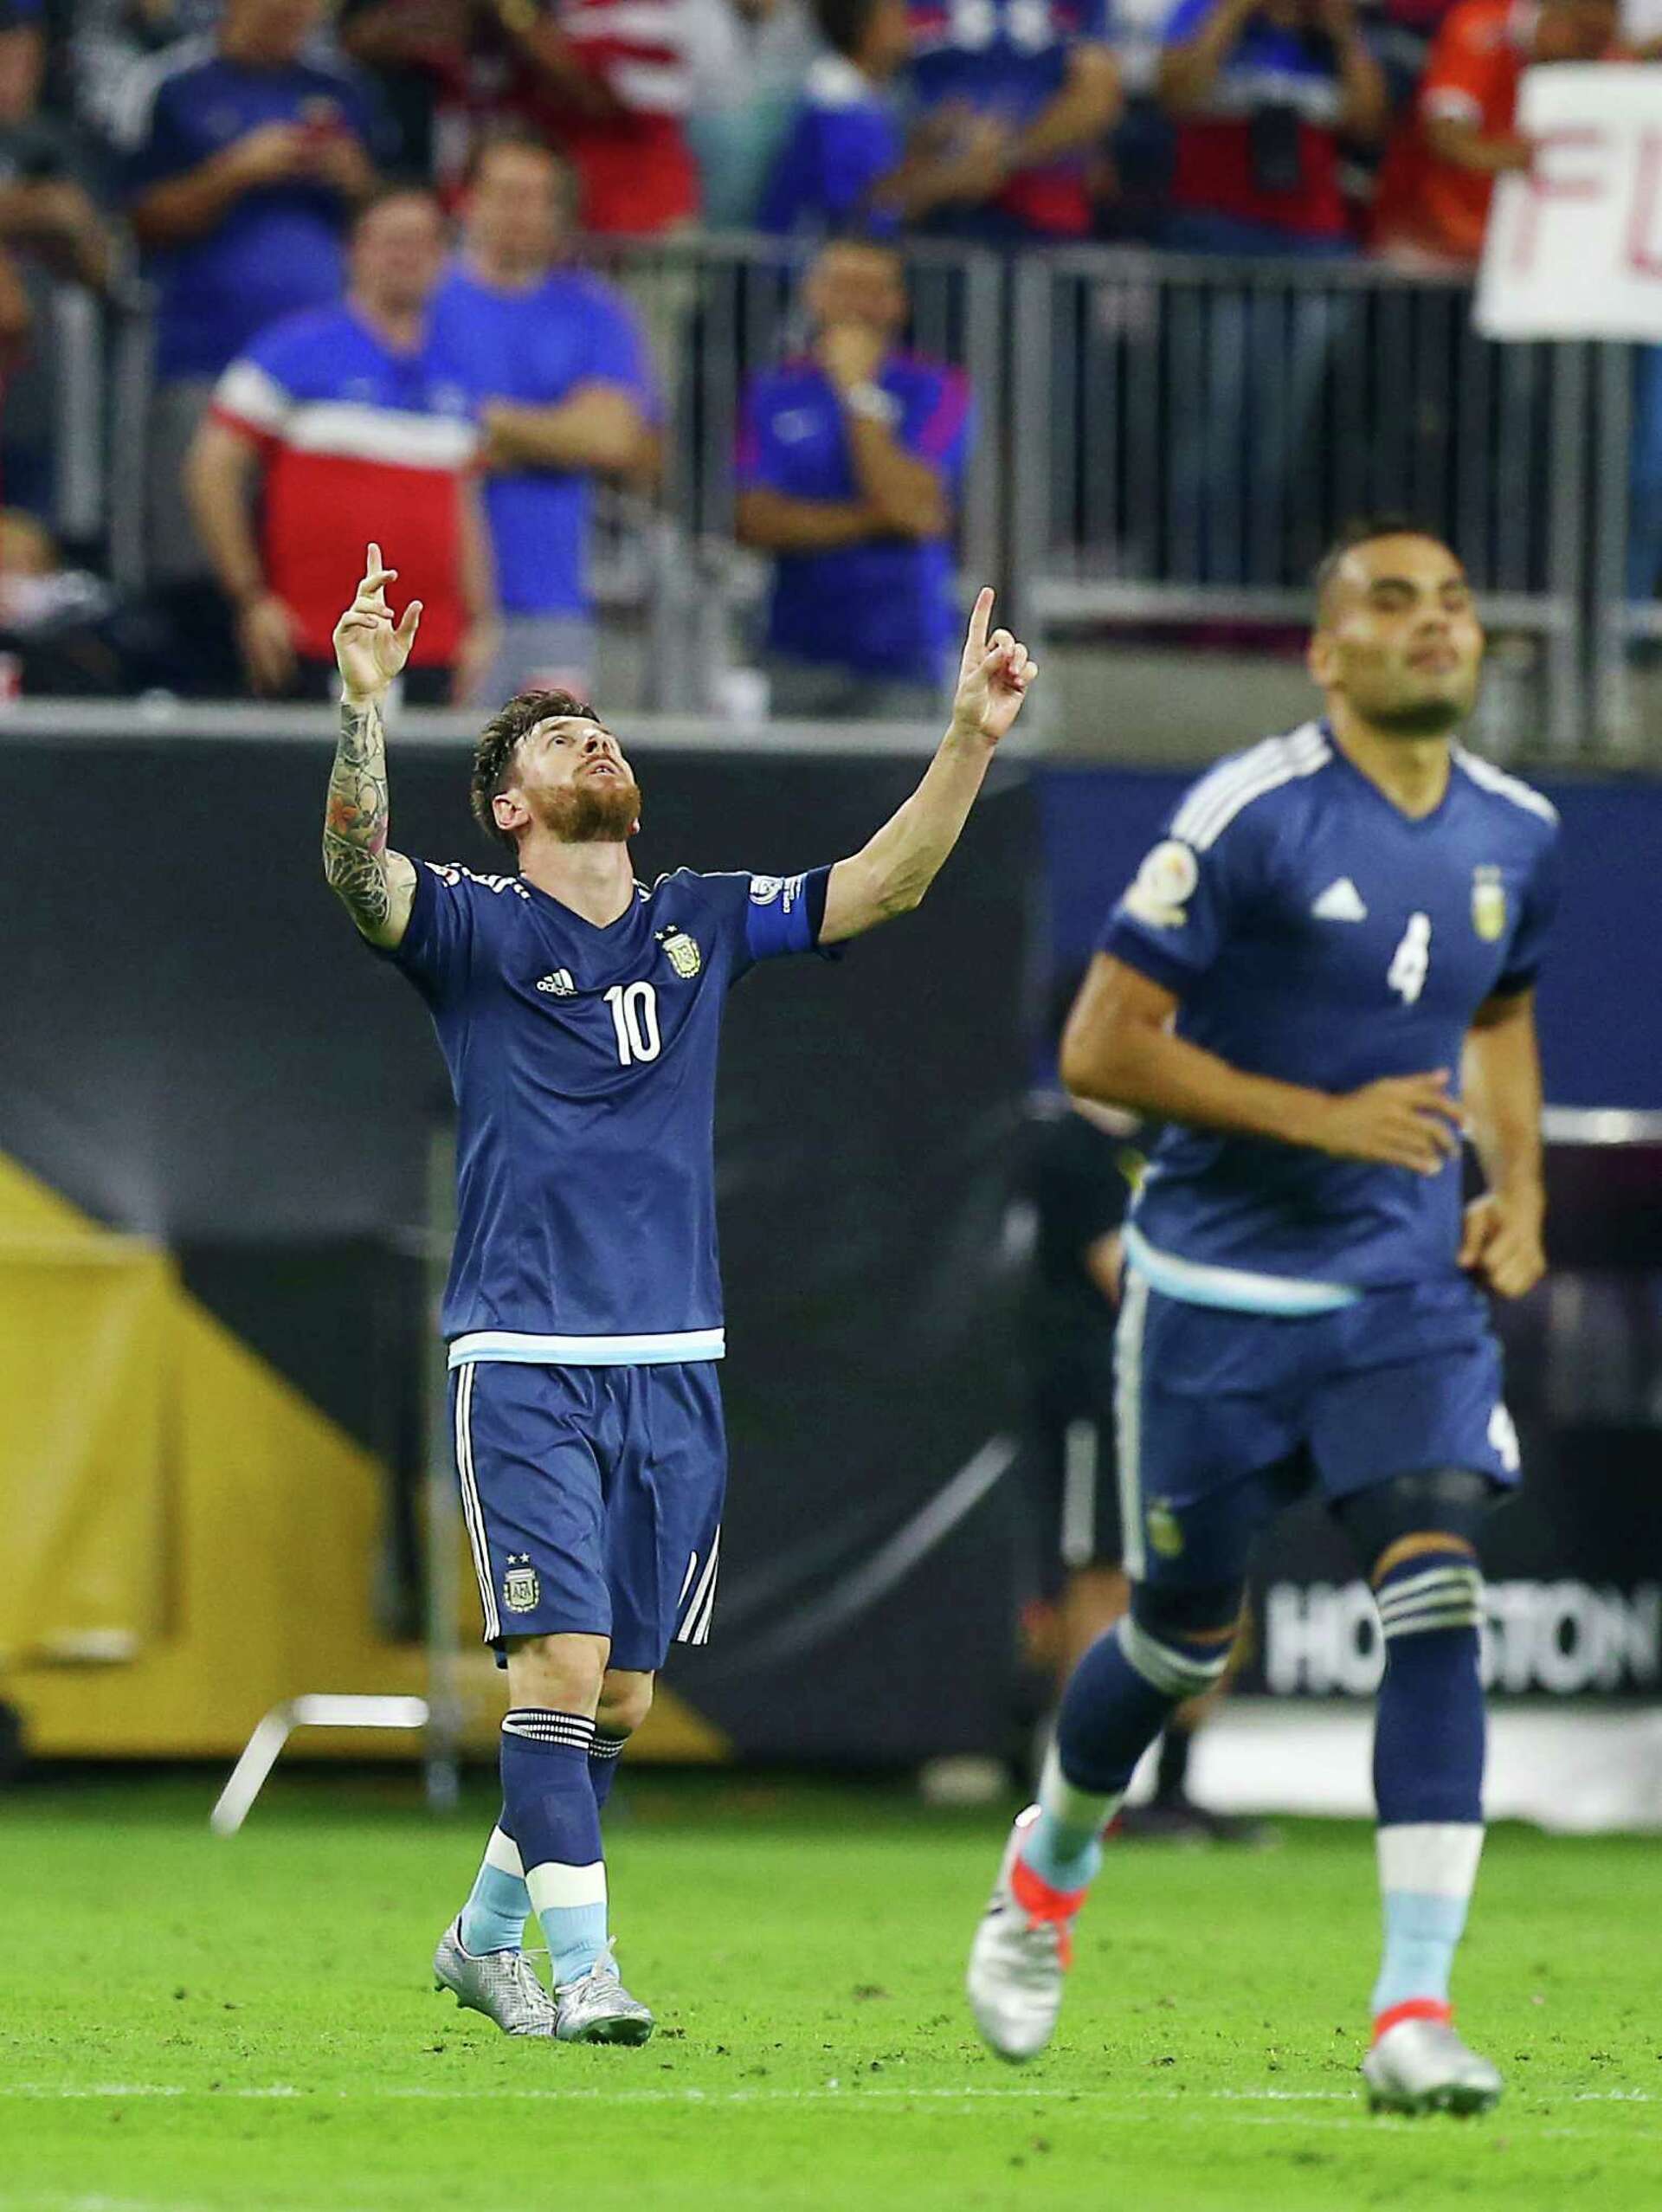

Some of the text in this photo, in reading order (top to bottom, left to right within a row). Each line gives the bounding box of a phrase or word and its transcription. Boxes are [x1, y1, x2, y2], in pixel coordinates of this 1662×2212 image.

[1388, 912, 1431, 1004] 4
[603, 981, 661, 1066] 10
[1266, 1580, 1660, 1693] HOTON
